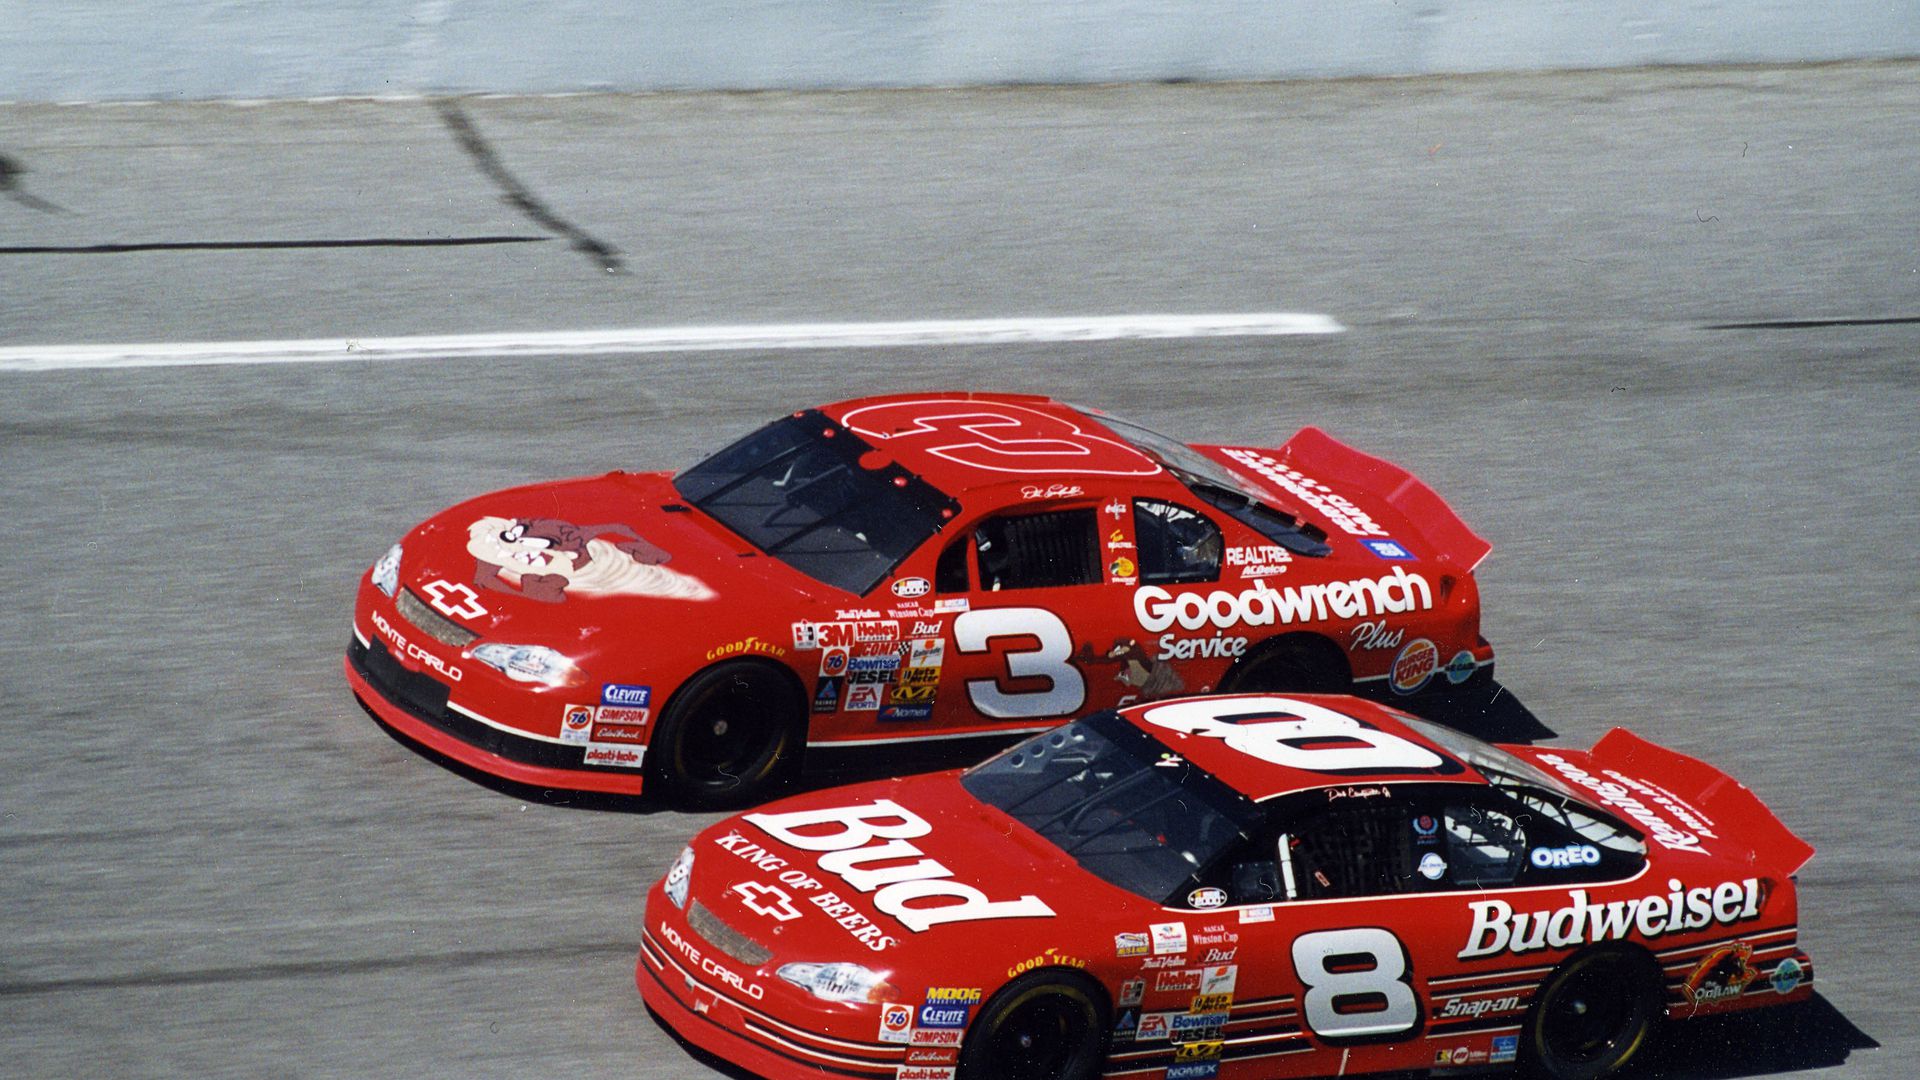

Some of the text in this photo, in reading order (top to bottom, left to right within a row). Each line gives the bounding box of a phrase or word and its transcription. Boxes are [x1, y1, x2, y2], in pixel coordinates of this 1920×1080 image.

[842, 400, 1162, 476] 3
[1133, 565, 1432, 633] Goodwrench
[887, 607, 935, 619] Winston Cup
[818, 623, 855, 647] 3M
[856, 621, 898, 640] Holley
[912, 620, 943, 635] Bud
[371, 610, 463, 681] MONTE CARLO
[1158, 630, 1248, 661] Service
[1351, 622, 1405, 652] Plus
[862, 642, 899, 656] COMP
[827, 656, 843, 669] 76
[953, 606, 1086, 719] 3
[847, 670, 898, 684] JESEL
[604, 684, 648, 702] CLEVITE
[850, 685, 878, 702] EA
[846, 701, 878, 709] SPORTS
[570, 712, 588, 724] 76
[599, 708, 645, 722] SIMPSON
[1143, 696, 1443, 770] 8
[1536, 753, 1711, 856] Remington
[741, 799, 1057, 932] Bud
[1532, 846, 1600, 868] OREO
[714, 831, 894, 952] KING OF BEERS
[1457, 878, 1759, 959] Budweiser
[1192, 934, 1223, 945] Winston
[1223, 931, 1239, 944] Cup
[660, 921, 764, 1000] MONTE CARLO
[1204, 946, 1238, 962] Bud
[1292, 928, 1418, 1037] 8
[926, 987, 982, 1000] MOOG
[921, 1006, 965, 1023] CLEVITE
[1440, 996, 1519, 1018] Snap-on
[887, 1012, 906, 1025] 76
[1140, 1015, 1168, 1031] EA
[1172, 1014, 1229, 1029] Bowman
[912, 1031, 959, 1044] SIMPSON
[1166, 1064, 1217, 1078] NOMEX
